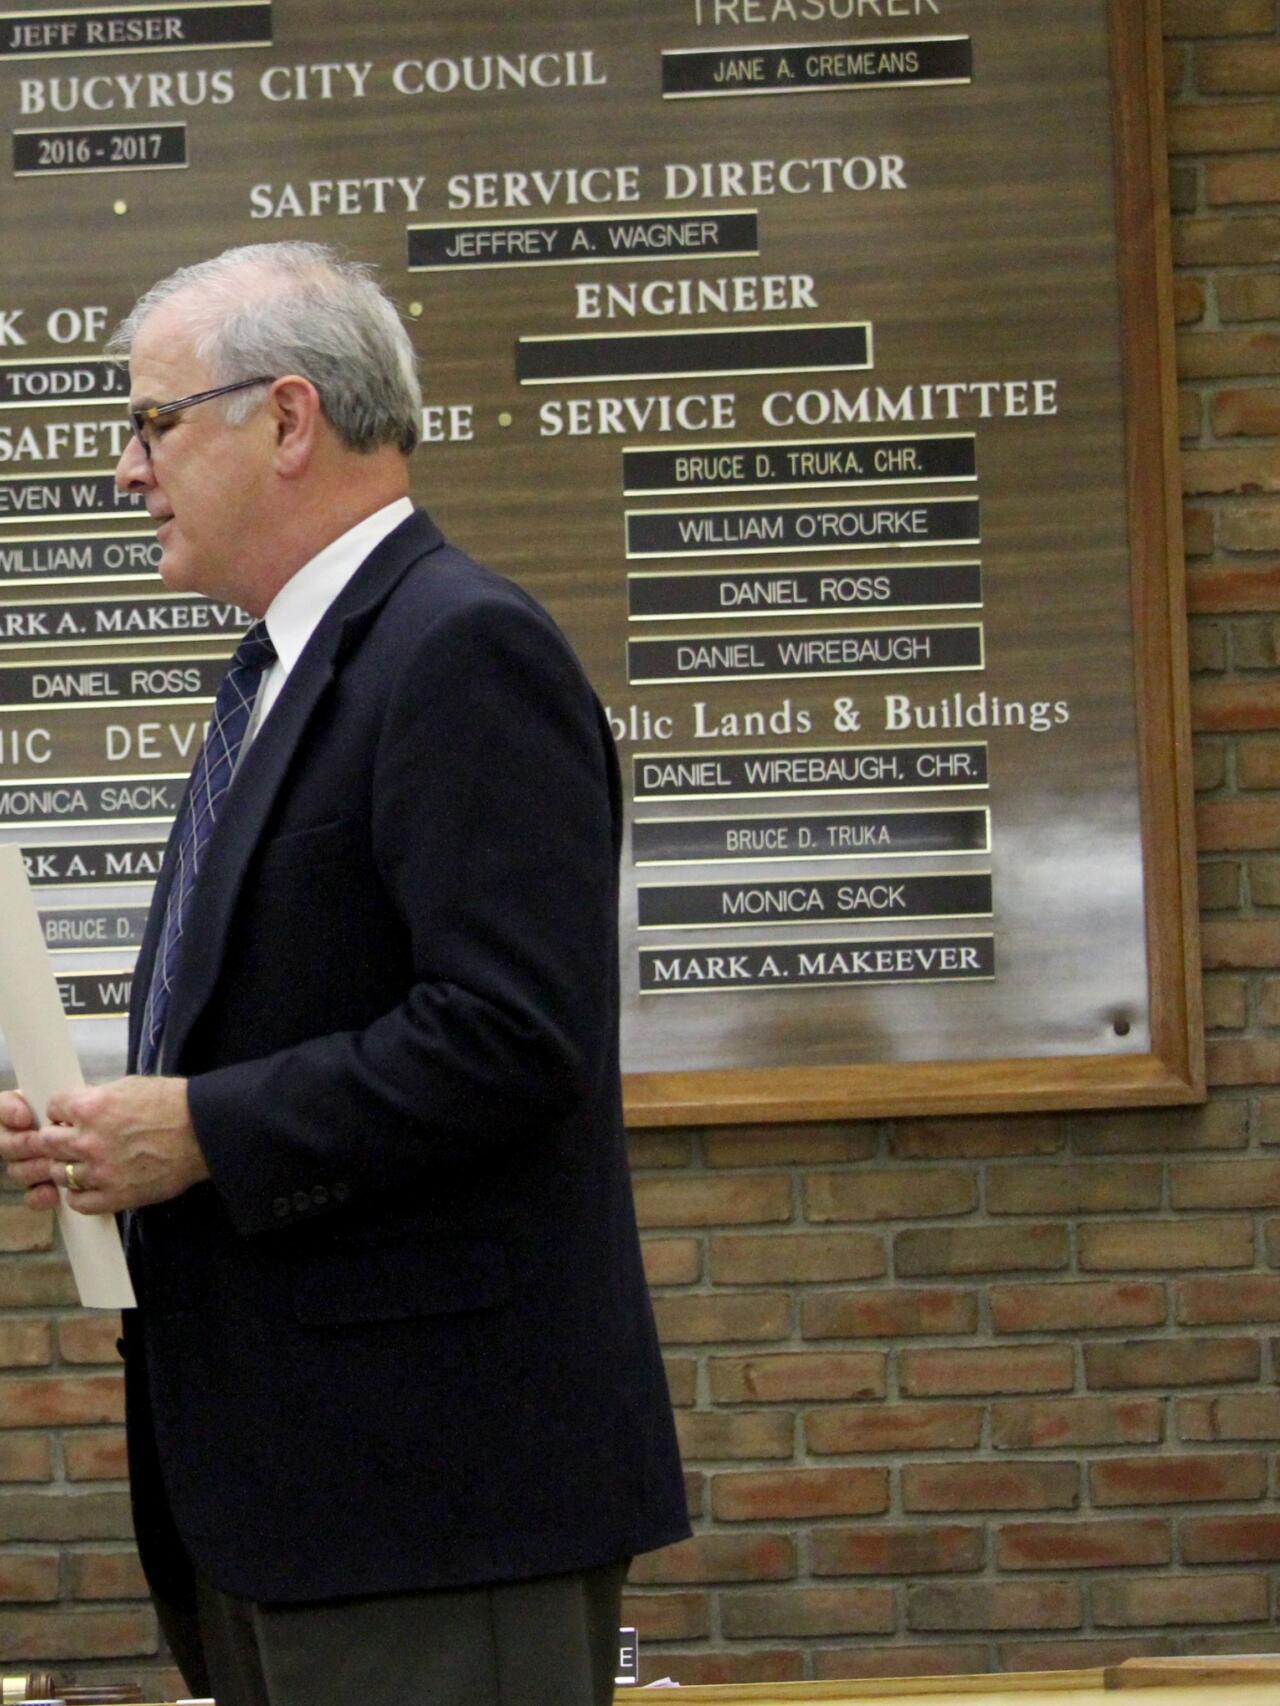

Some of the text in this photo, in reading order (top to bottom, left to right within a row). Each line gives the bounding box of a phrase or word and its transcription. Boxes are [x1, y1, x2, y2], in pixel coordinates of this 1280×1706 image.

[9, 17, 185, 49] JEFF RESER
[19, 69, 235, 114] BUCYRUS
[259, 62, 373, 101] CITY
[391, 50, 607, 95] COUNCIL
[713, 51, 920, 83] JANE A. CREMEANS
[38, 138, 91, 165] 2016
[110, 133, 162, 161] 2017
[249, 154, 908, 219] SAFETY SERVICE DIRECTOR
[445, 221, 719, 258] JEFFREY A. WAGNER
[575, 273, 818, 319] ENGINEER
[47, 306, 108, 344] OF
[6, 368, 124, 397] TODD J.
[539, 379, 1058, 437] SERVICE COMMITTEE
[675, 455, 745, 482] BRUCE
[756, 454, 776, 478] D.
[874, 447, 923, 473] CHR.
[71, 483, 103, 508] W.
[678, 510, 928, 543] WILLIAM O'ROURKE
[103, 543, 164, 569] O'RO
[720, 576, 891, 606] DANIEL ROSS
[56, 611, 86, 637] A.
[95, 603, 254, 633] MAKEEVE
[677, 636, 931, 671] DANIEL WIREBAUGH
[32, 666, 202, 698] DANIEL ROSS
[604, 690, 1071, 741] blic Lands & Buildings
[643, 752, 978, 790] DANIEL WIREBAUGH, CHR.
[726, 825, 891, 851] BRUCE D. TRUKA
[65, 853, 96, 876] A.
[722, 884, 907, 915] MONICA SACK
[46, 917, 107, 942] BRUCE
[117, 917, 135, 939] D.
[653, 946, 982, 983] MARK A. MAKEEVER
